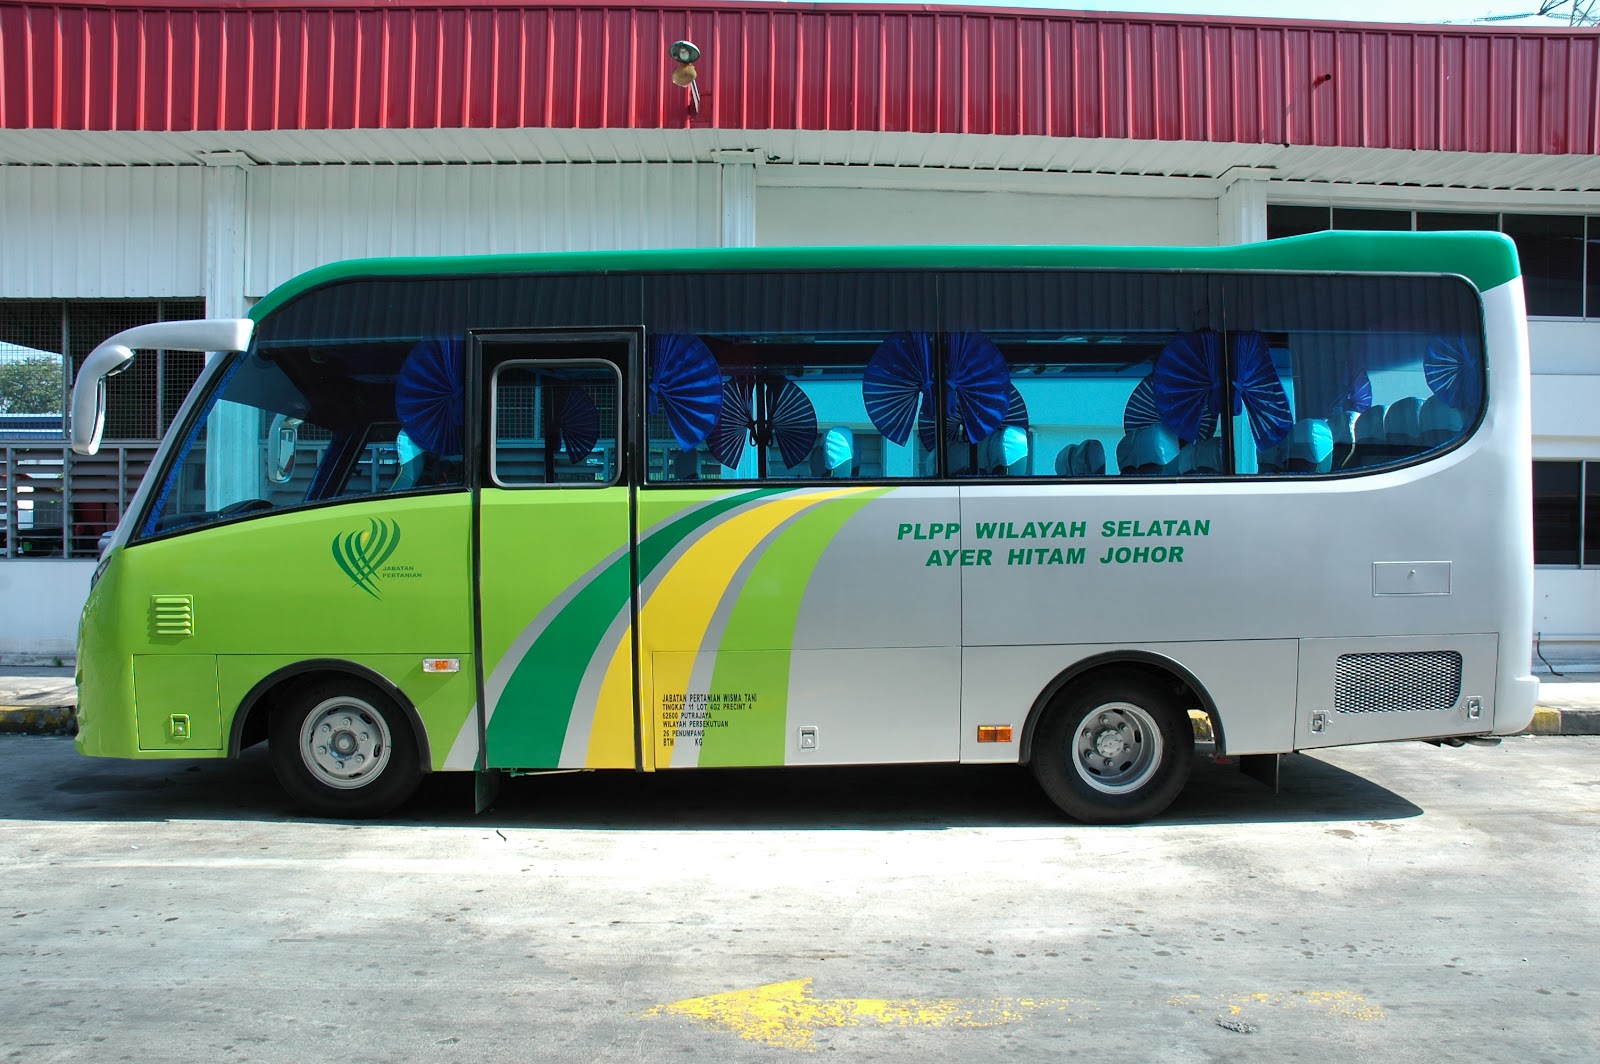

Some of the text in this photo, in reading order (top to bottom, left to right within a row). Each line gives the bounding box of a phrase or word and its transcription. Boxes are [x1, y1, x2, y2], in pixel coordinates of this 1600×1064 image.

[897, 519, 1210, 540] PLPP WILAYAH SELATAN
[925, 546, 1184, 566] AYER HITAM JOHOR
[662, 693, 757, 702] JABATAN PERTANIAN WISMA TANI
[662, 703, 685, 711] TINGKAT
[688, 703, 693, 711] 11
[697, 703, 707, 711] LOT
[723, 703, 746, 711] PRECINT
[689, 720, 728, 728] PERSEKUTUAN
[663, 738, 703, 747] BTM KG
